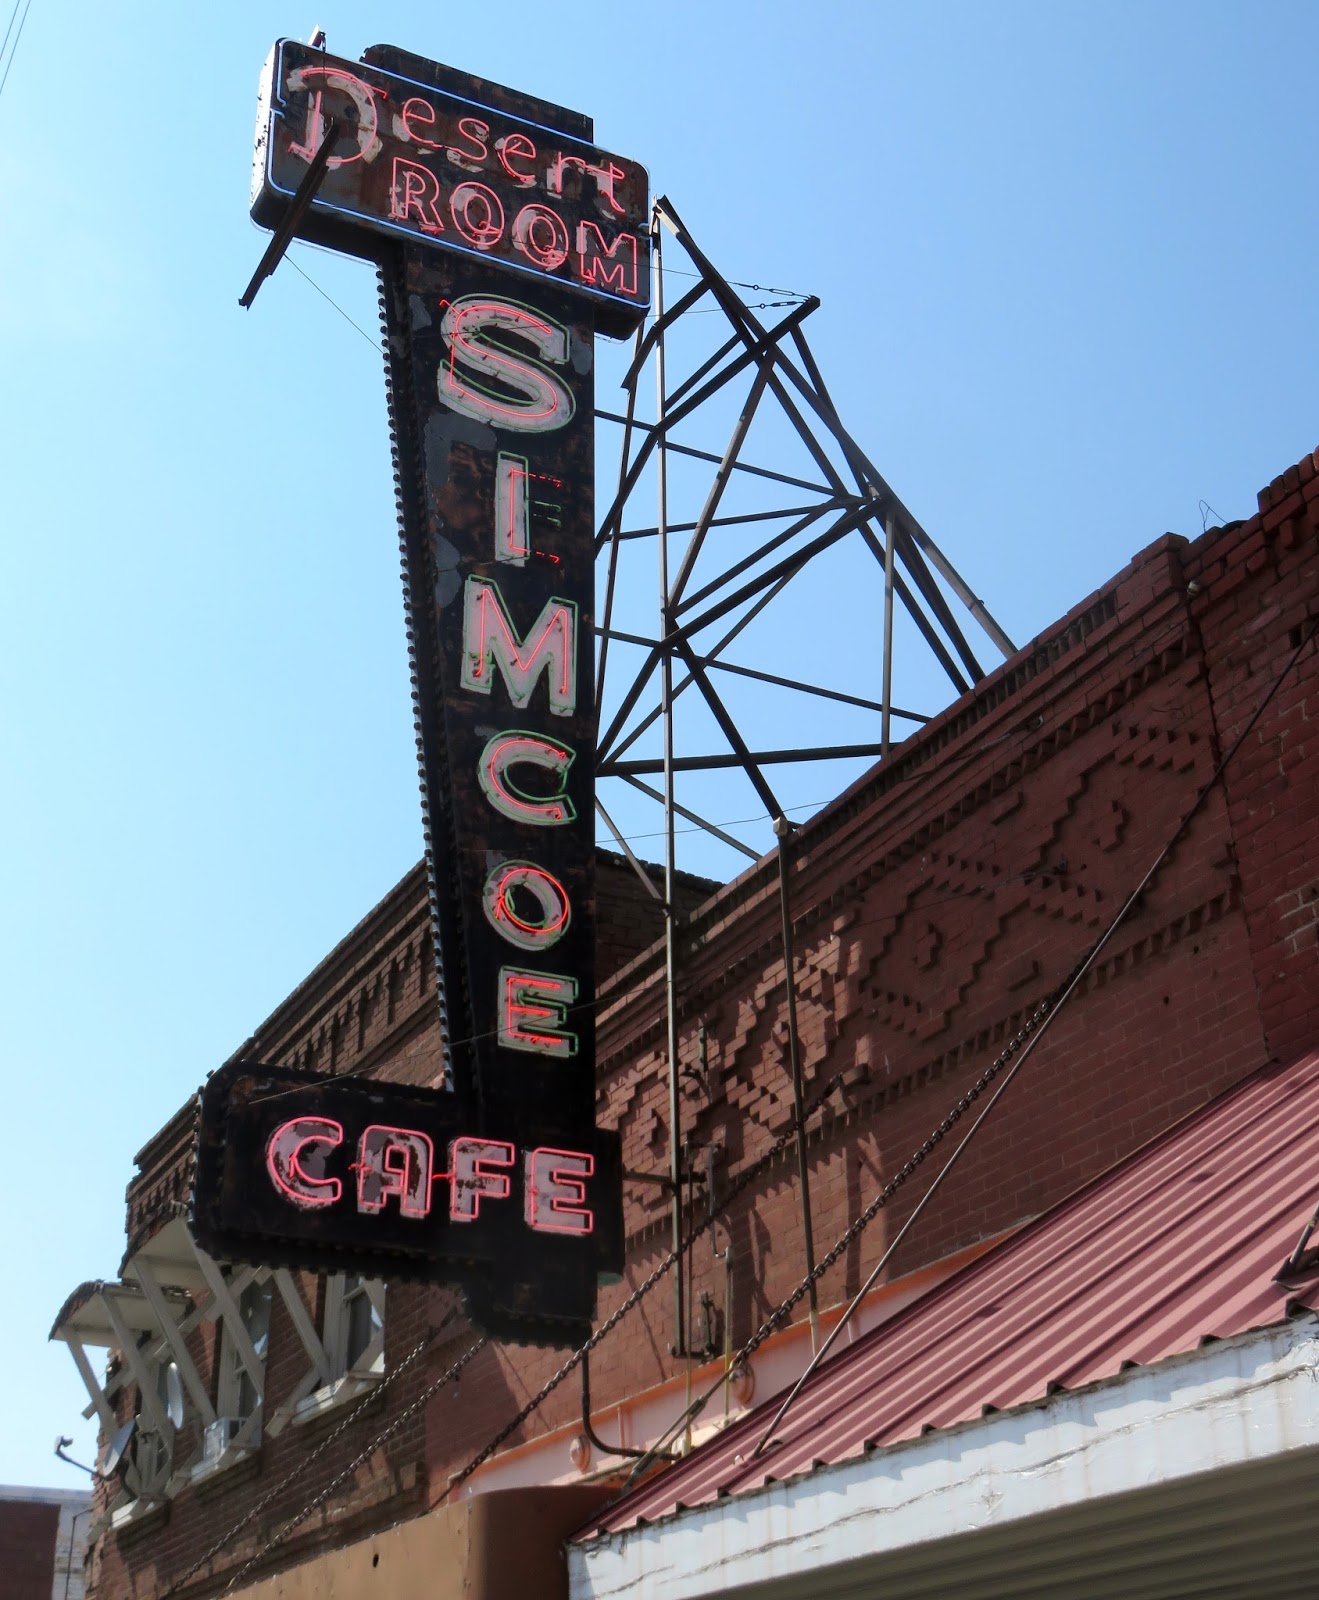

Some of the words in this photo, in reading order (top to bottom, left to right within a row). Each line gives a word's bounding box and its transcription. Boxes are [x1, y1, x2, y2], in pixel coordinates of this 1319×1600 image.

[286, 65, 625, 217] Desert
[389, 156, 637, 294] ROOM
[437, 293, 579, 1057] SIMCOE
[266, 1115, 594, 1235] CAFE
